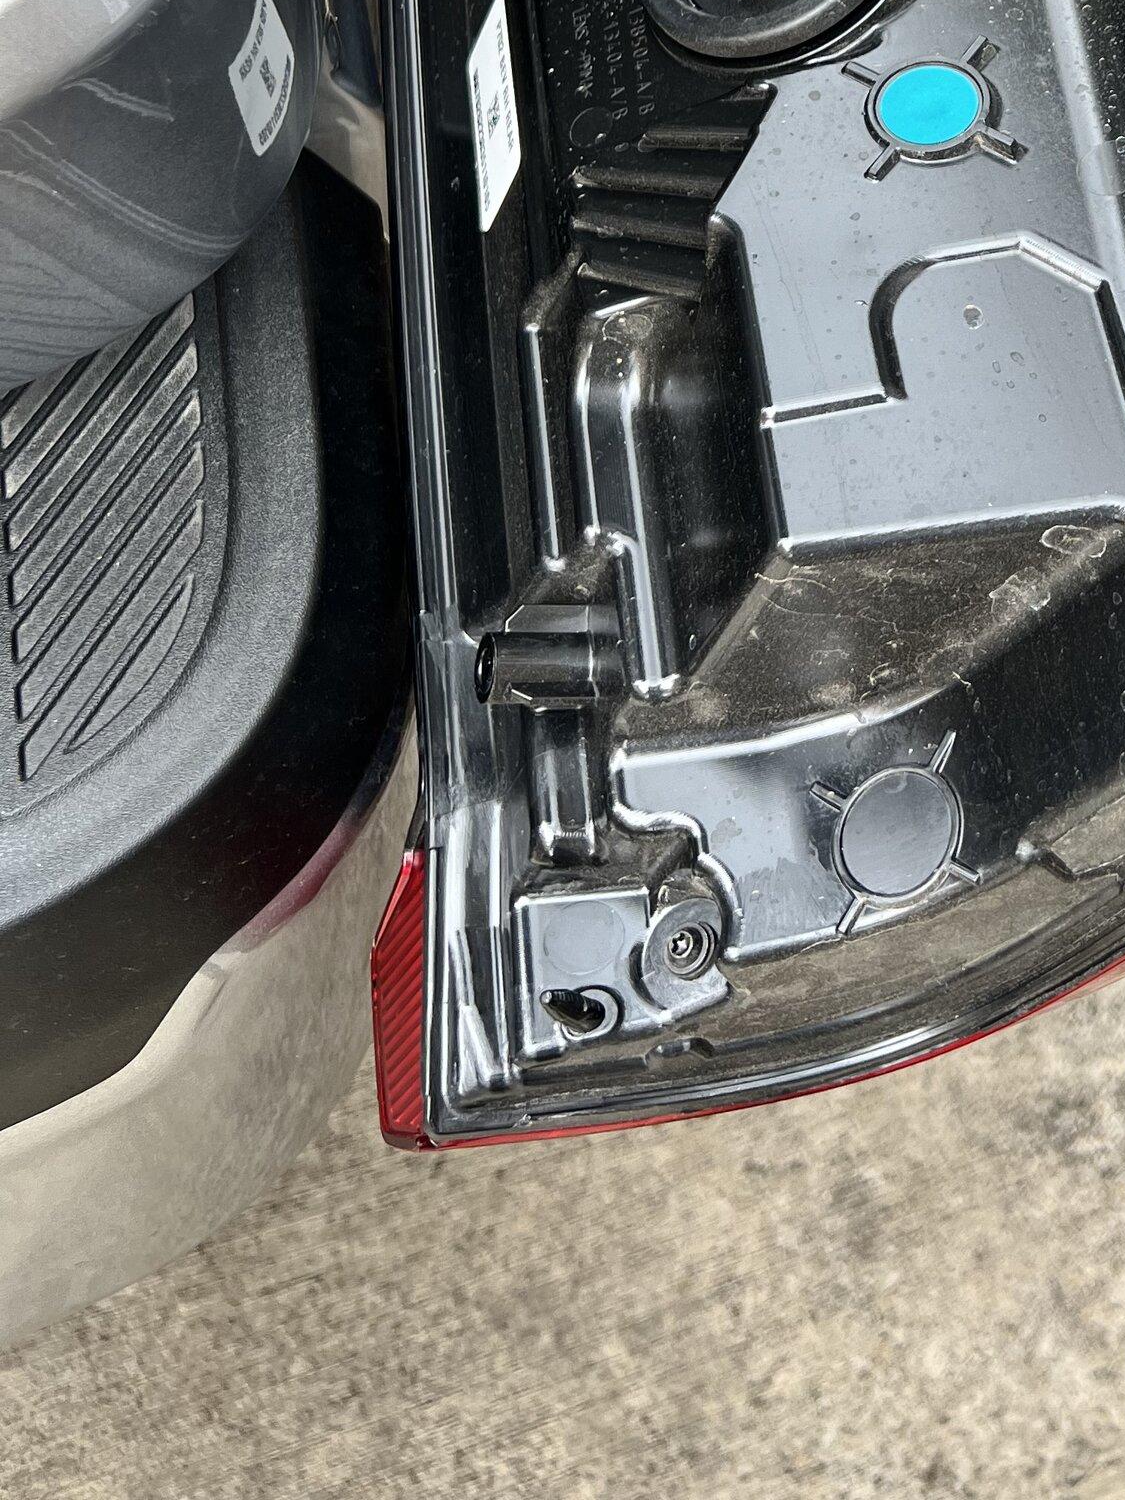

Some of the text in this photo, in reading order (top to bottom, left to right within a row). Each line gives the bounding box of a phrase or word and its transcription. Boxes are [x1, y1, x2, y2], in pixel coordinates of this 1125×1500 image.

[499, 53, 507, 86] BEV
[502, 83, 509, 111] RH
[504, 108, 514, 153] REAR
